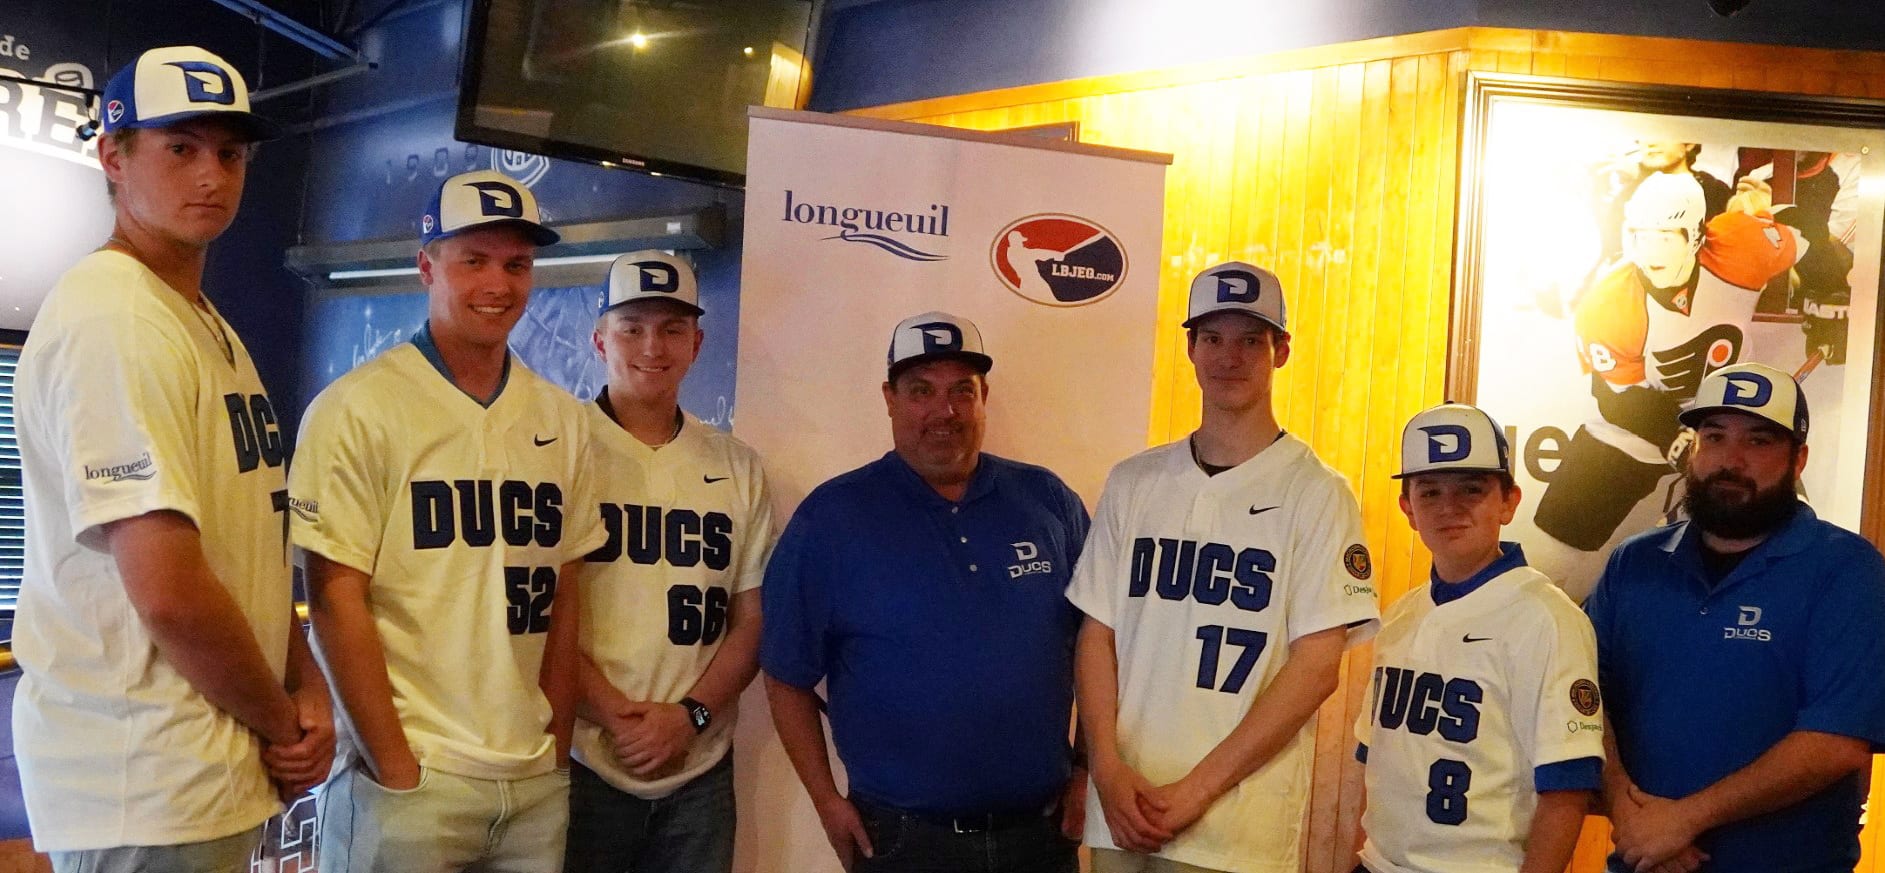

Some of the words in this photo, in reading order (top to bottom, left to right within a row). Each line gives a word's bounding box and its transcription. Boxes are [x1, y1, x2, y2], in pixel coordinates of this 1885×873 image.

[161, 61, 236, 105] D
[462, 181, 524, 217] D
[782, 190, 950, 240] longueuil
[627, 261, 680, 292] D
[1208, 269, 1260, 303] D
[1719, 371, 1773, 407] D
[1416, 424, 1472, 464] D
[84, 451, 153, 481] longueuil
[410, 479, 563, 549] DUCS
[1008, 561, 1052, 578] DUCS
[1128, 537, 1277, 612] DUCS
[504, 566, 557, 635] 52
[667, 584, 729, 646] 66
[1723, 627, 1771, 642] DUCS
[1196, 624, 1268, 694] 17
[1426, 758, 1472, 826] 8
